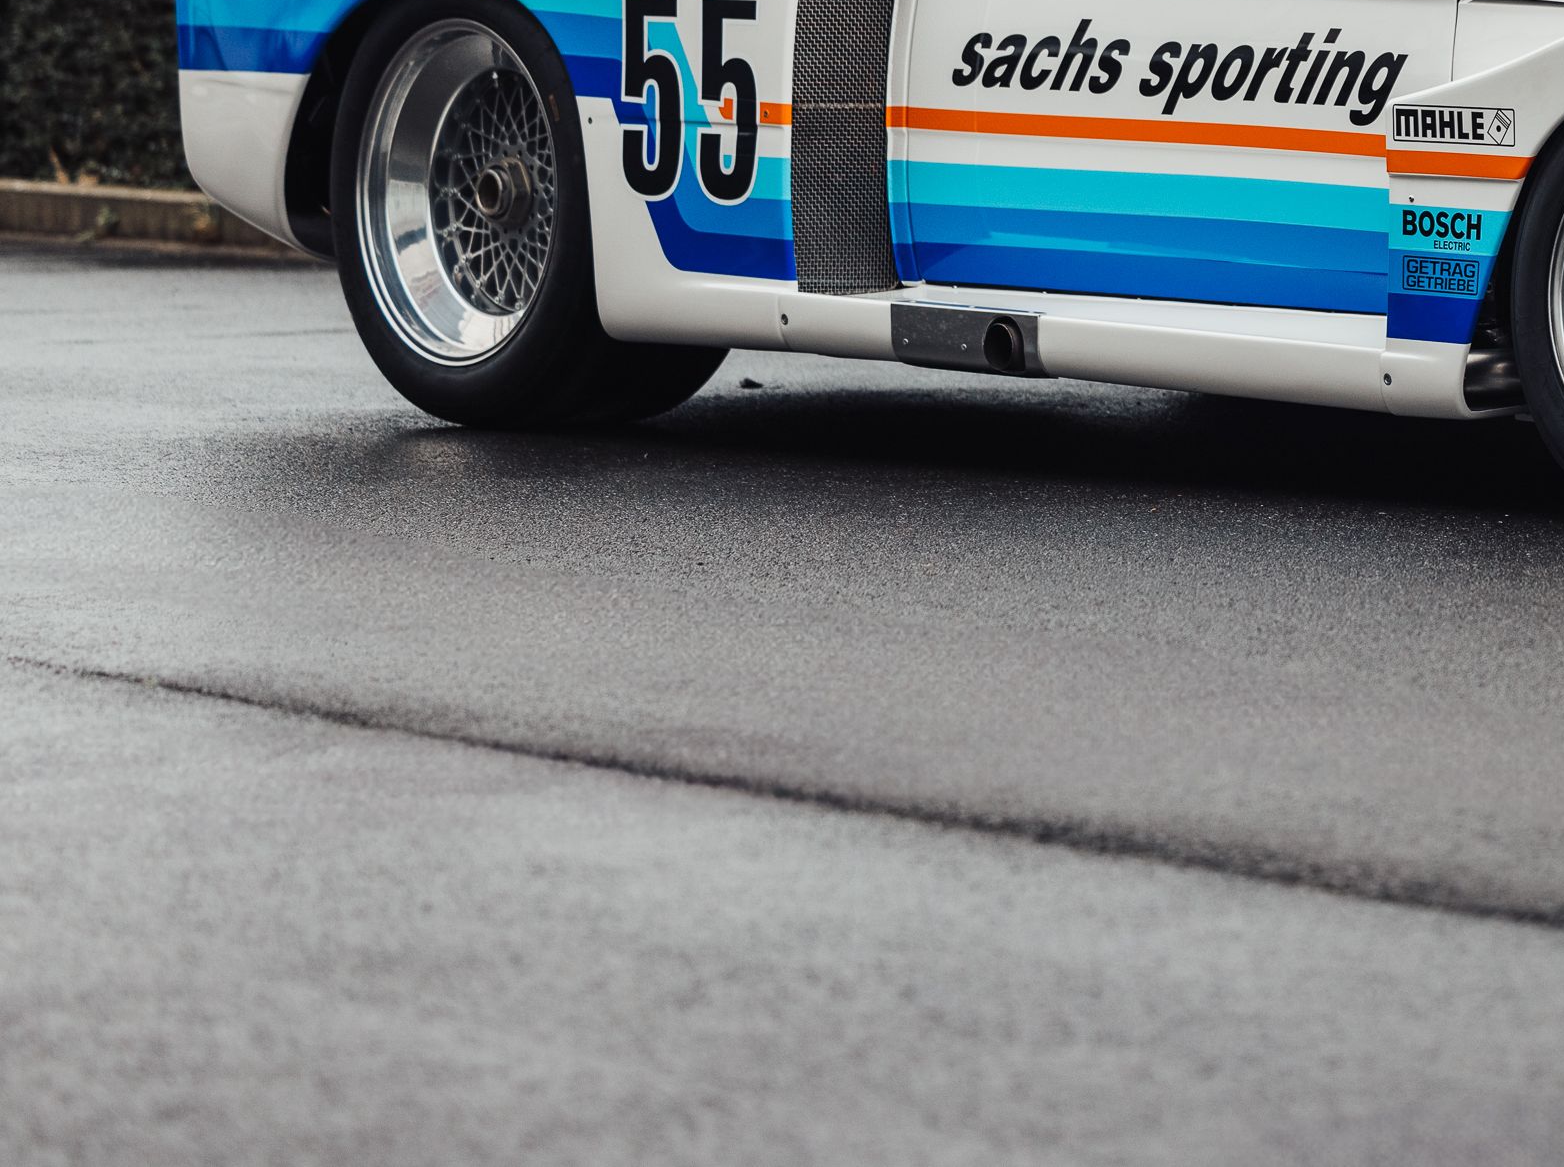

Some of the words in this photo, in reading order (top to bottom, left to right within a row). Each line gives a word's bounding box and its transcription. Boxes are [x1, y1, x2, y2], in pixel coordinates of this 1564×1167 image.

[952, 18, 1131, 95] sachs
[1138, 28, 1408, 126] sporting
[1395, 108, 1485, 141] MAHLE
[1402, 209, 1482, 241] BOSCH
[1433, 240, 1471, 252] ELECTRIC
[1406, 258, 1476, 277] GETRAG
[1406, 275, 1475, 293] GETRIEBE
